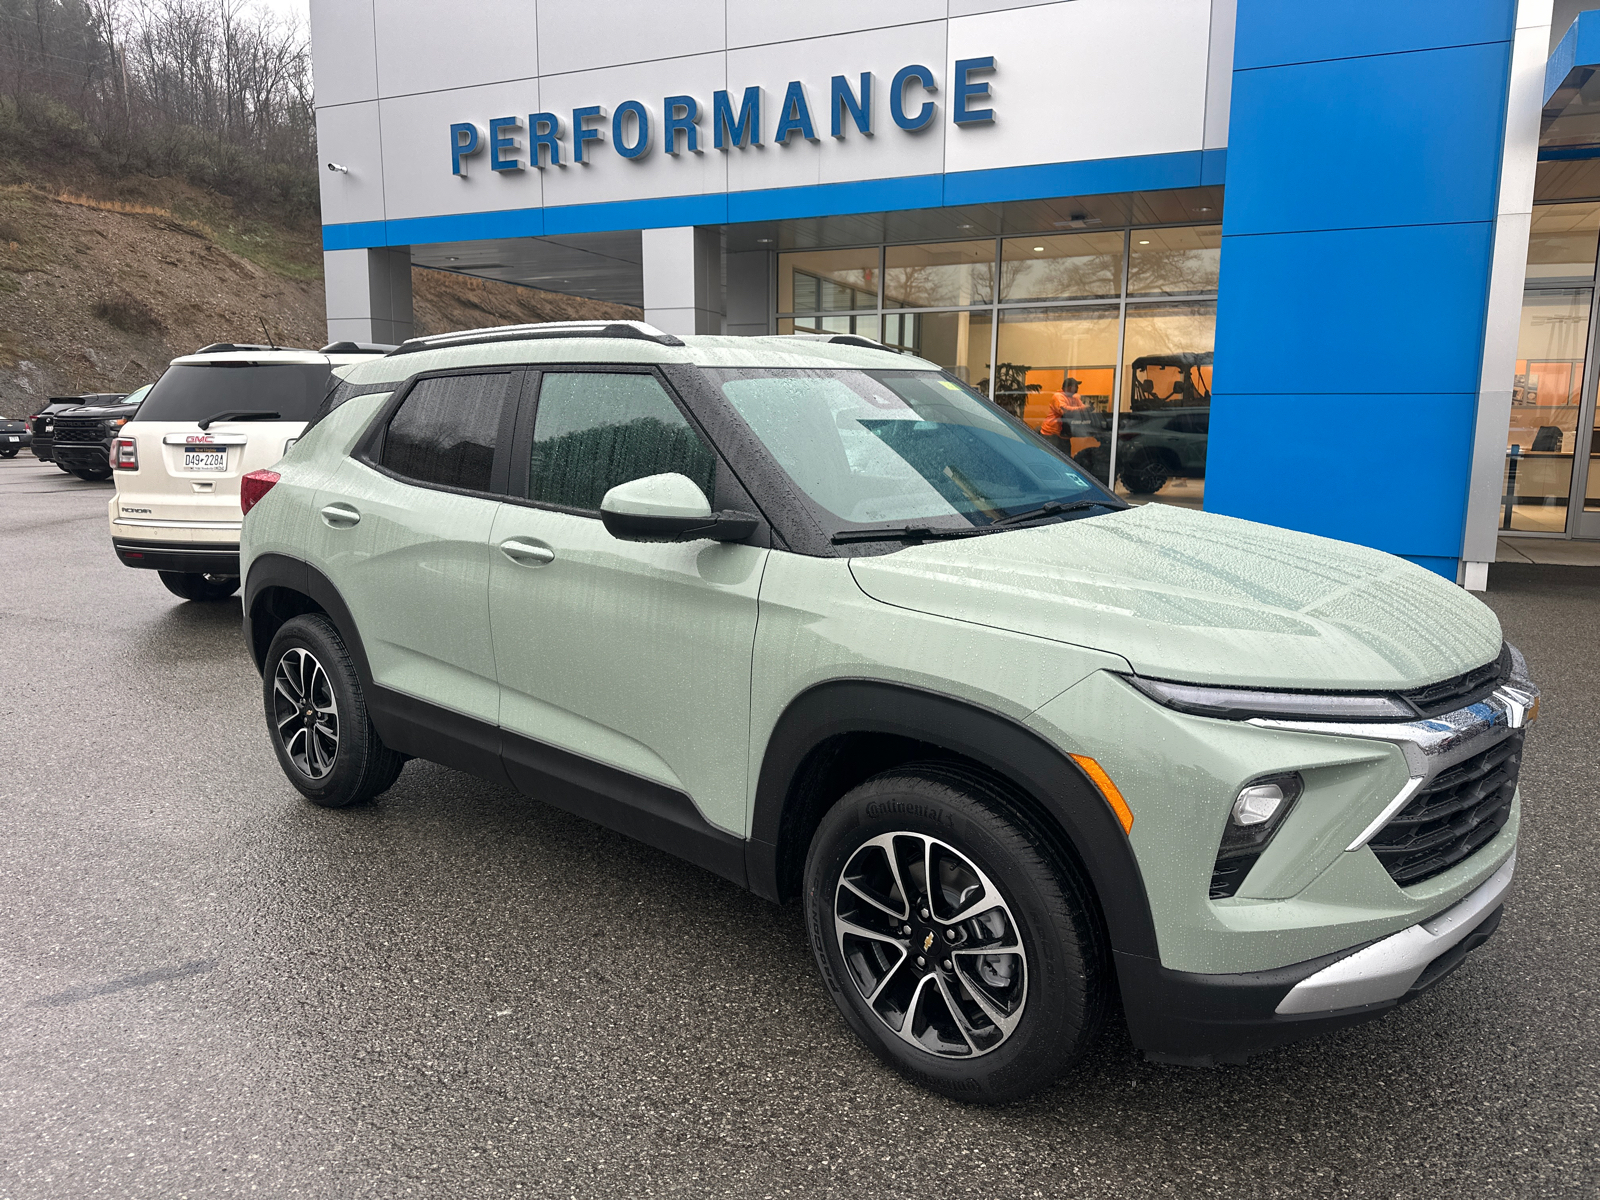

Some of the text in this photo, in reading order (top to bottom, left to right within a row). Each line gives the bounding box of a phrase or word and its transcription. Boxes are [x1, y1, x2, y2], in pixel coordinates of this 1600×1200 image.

[450, 56, 998, 179] PERFORMANCE
[186, 435, 215, 443] GMC
[865, 798, 944, 824] Continental
